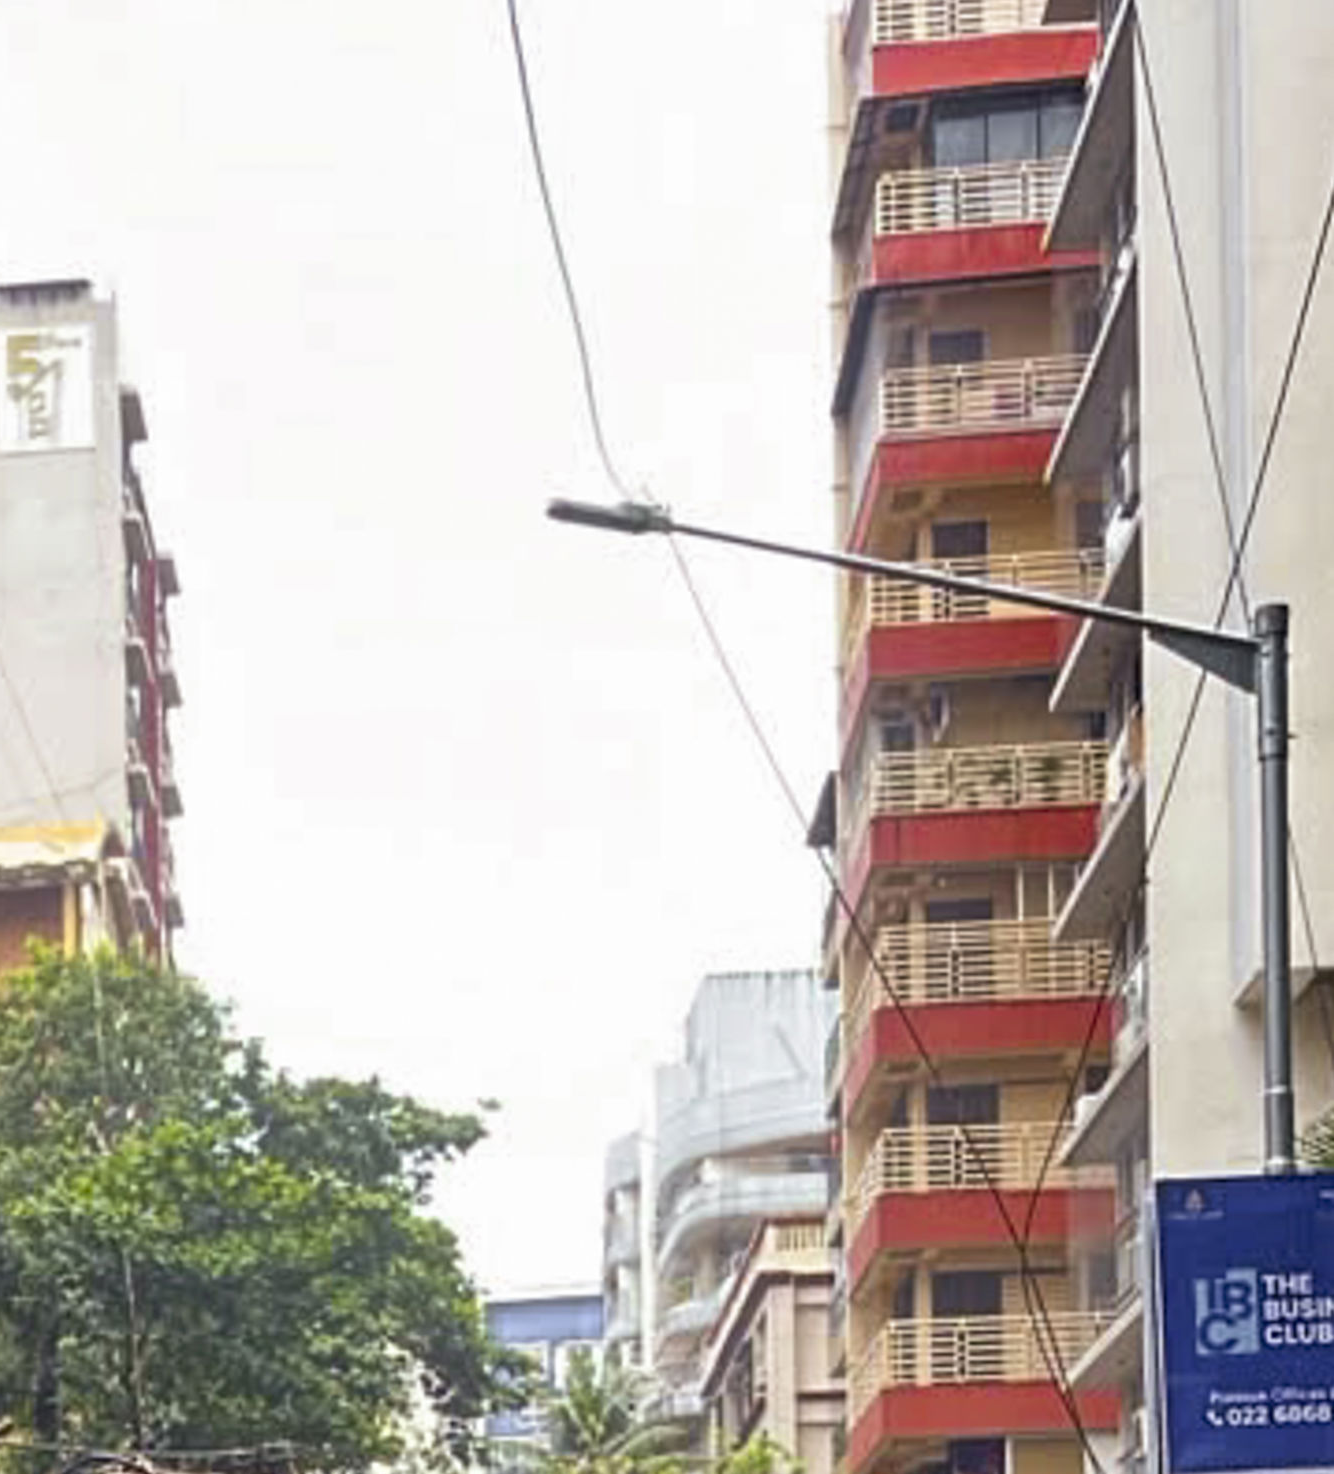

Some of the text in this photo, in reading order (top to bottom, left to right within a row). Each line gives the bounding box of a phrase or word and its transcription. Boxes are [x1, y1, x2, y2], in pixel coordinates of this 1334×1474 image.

[1261, 1274, 1312, 1296] THE
[1265, 1322, 1334, 1345] CLUB
[1226, 1405, 1268, 1426] 022
